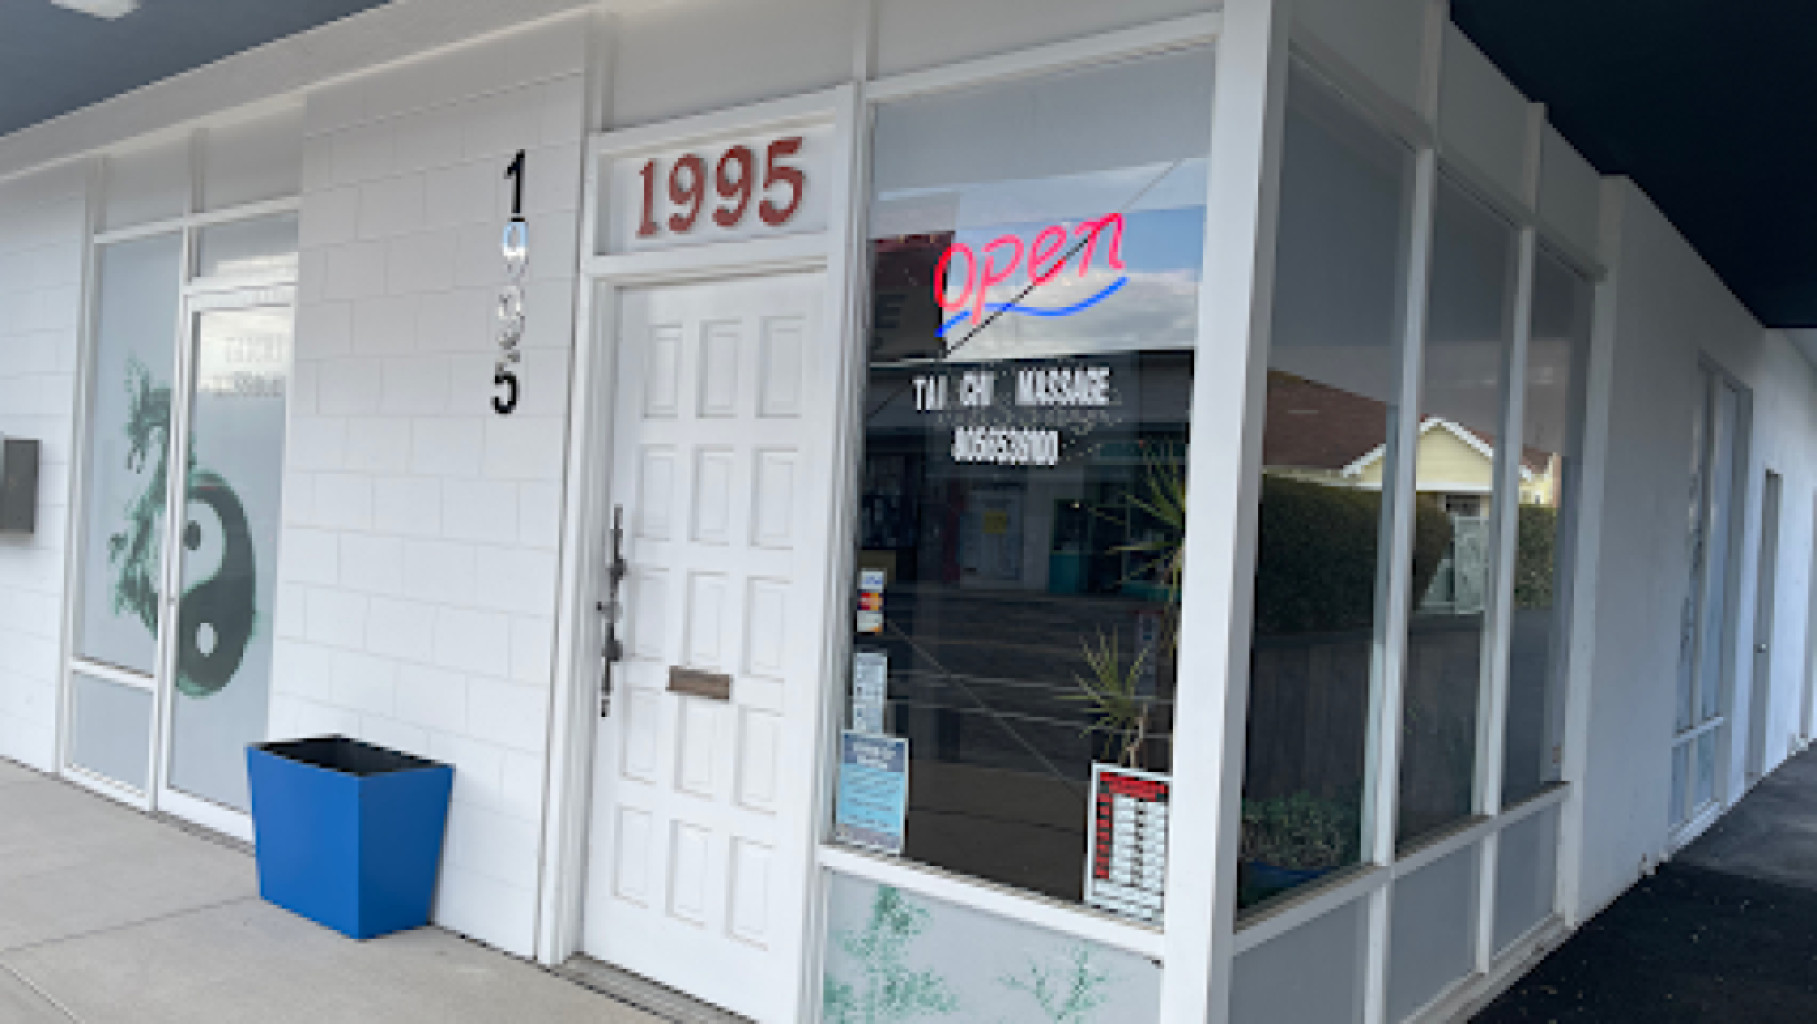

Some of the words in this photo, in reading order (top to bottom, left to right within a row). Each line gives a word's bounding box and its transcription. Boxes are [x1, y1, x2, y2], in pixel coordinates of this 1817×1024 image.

[635, 136, 806, 239] 1995
[911, 374, 948, 411] TAI
[960, 370, 995, 406] CHI
[1014, 366, 1111, 406] MASSAGE
